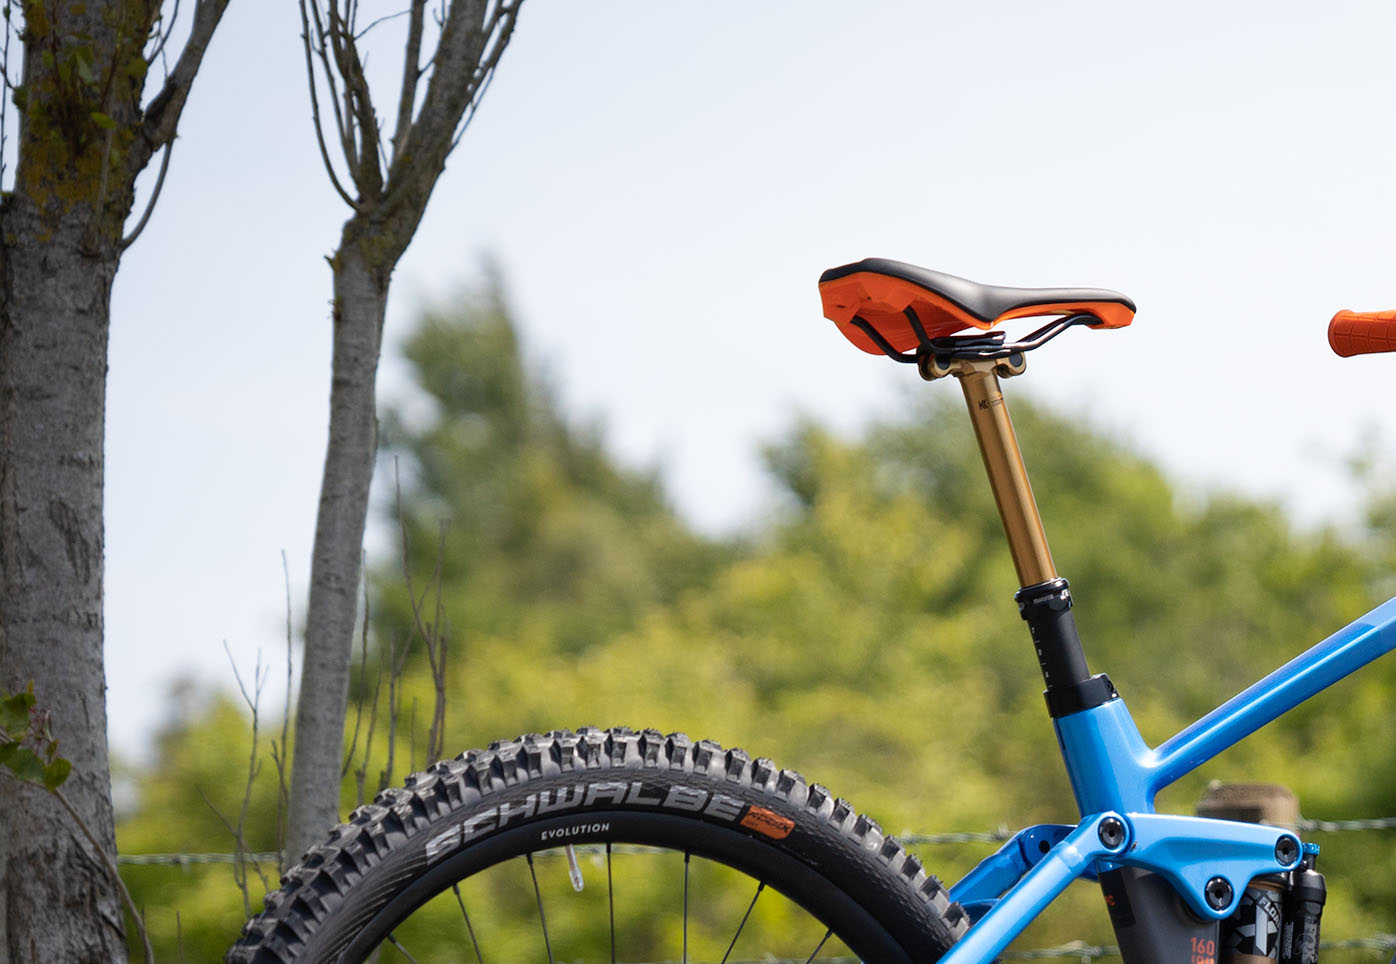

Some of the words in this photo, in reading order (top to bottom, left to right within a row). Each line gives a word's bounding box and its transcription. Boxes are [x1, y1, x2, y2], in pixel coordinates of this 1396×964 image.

[425, 782, 745, 866] SCHWALBE
[540, 823, 611, 841] EVOLUTION
[1190, 936, 1216, 957] 160
